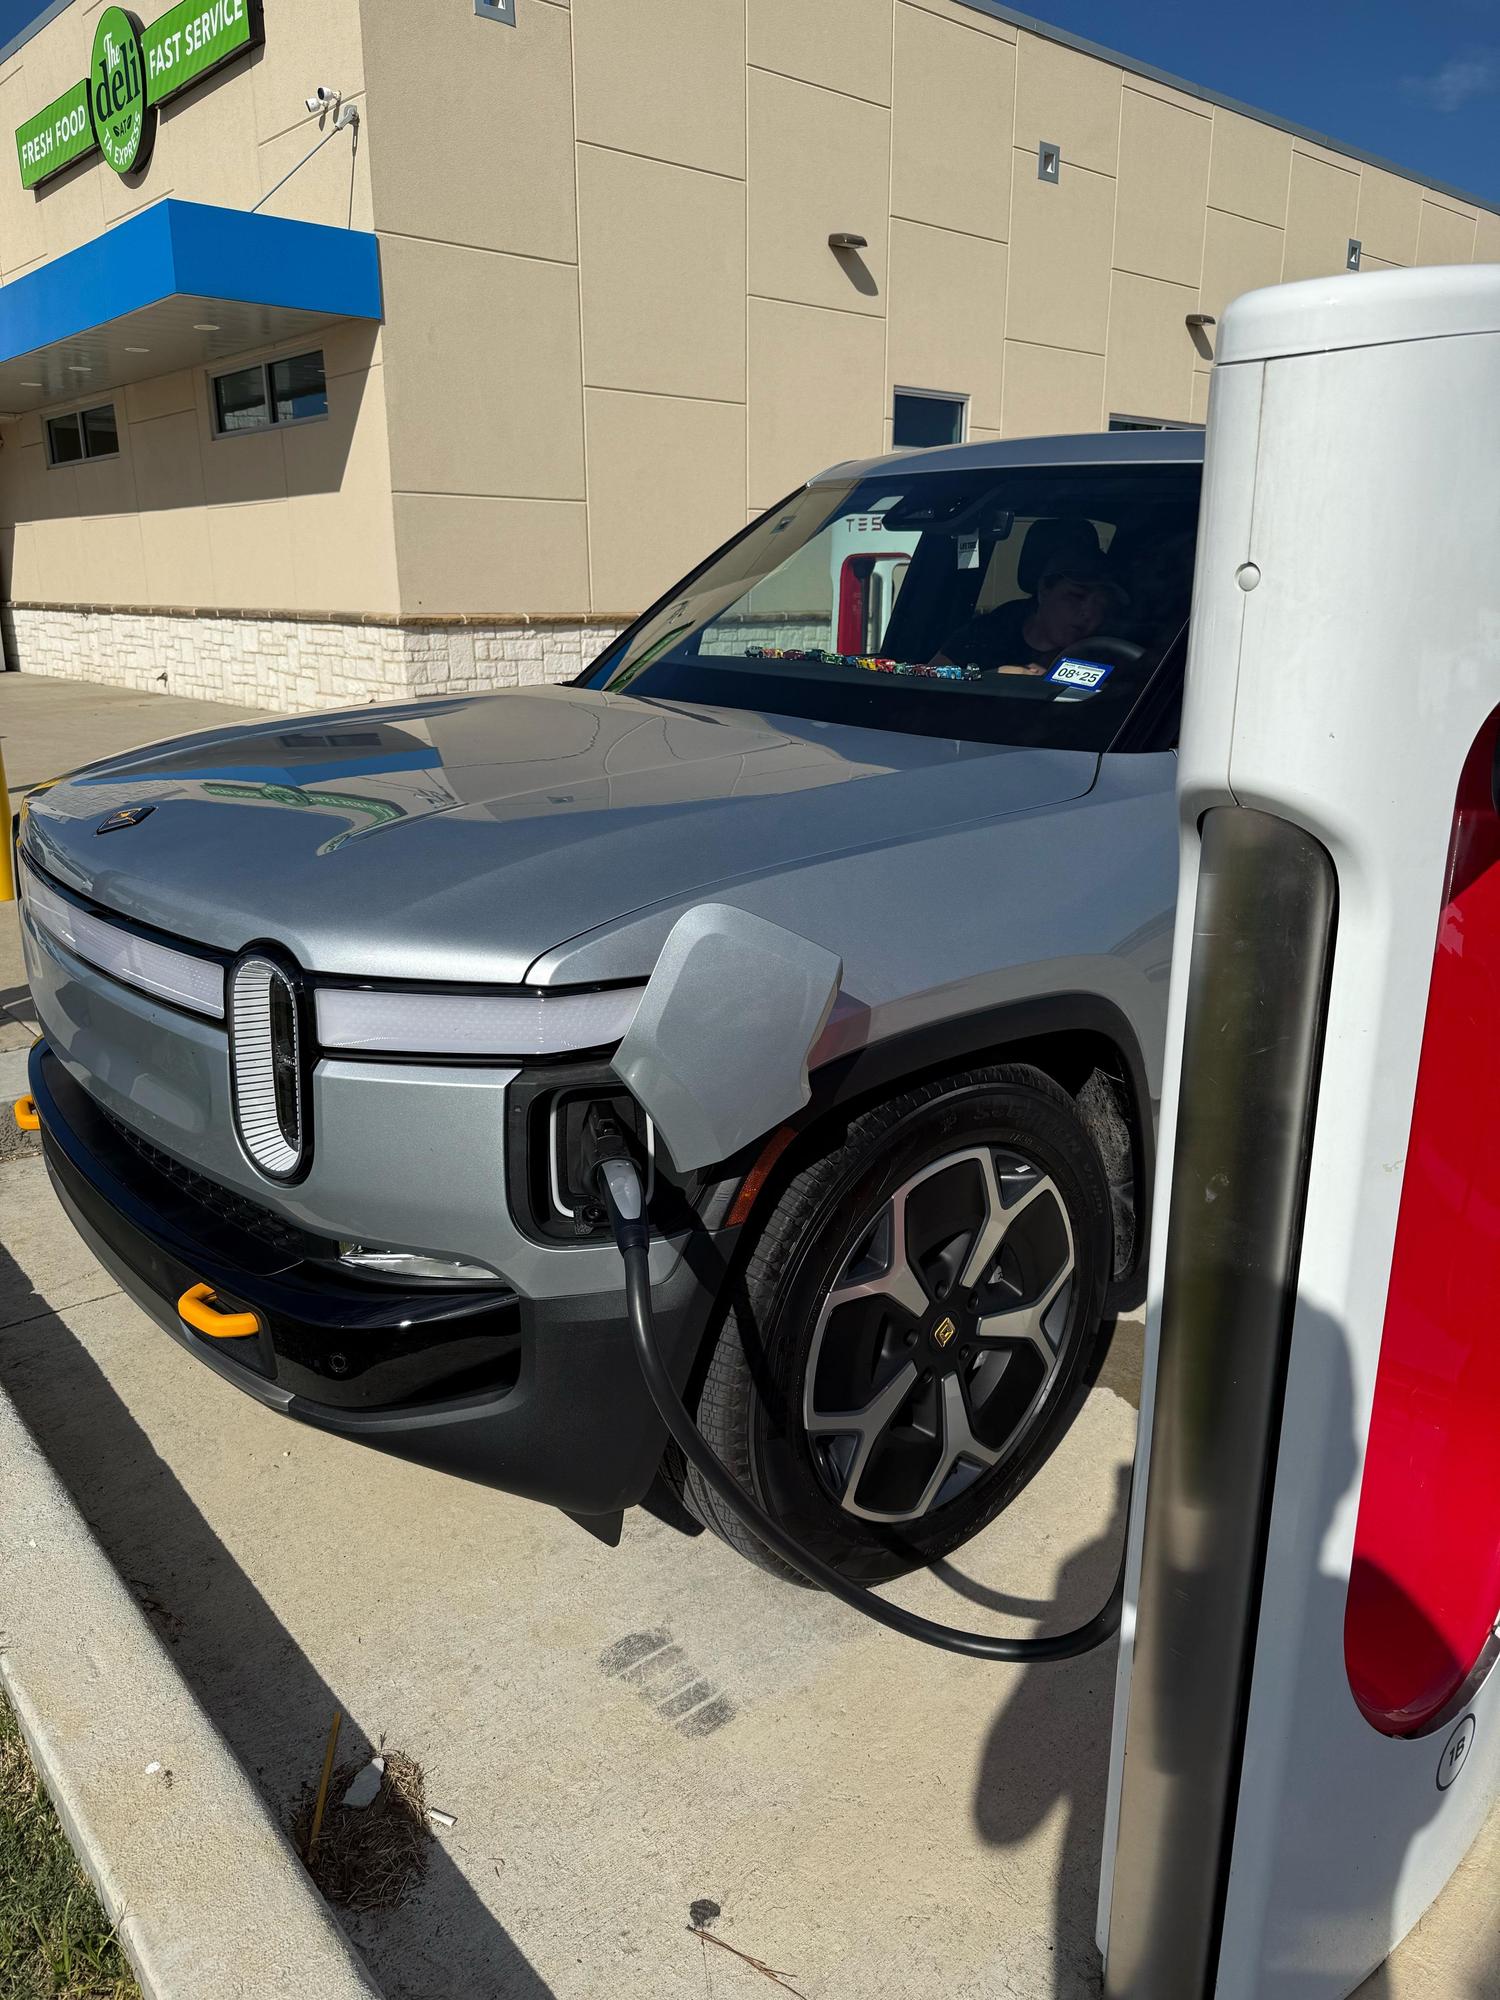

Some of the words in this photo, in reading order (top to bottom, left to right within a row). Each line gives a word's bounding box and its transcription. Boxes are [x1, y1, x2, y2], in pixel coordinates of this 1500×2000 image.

[103, 31, 120, 75] The
[149, 31, 181, 80] FAST
[185, 0, 243, 56] SERVICE
[96, 38, 141, 122] deli
[22, 127, 53, 169] FRESH
[55, 105, 86, 147] FOOD
[104, 128, 113, 157] TA
[114, 110, 141, 165] EXPRESS
[845, 516, 882, 532] TES
[1057, 667, 1076, 679] 08
[1079, 671, 1099, 683] 25
